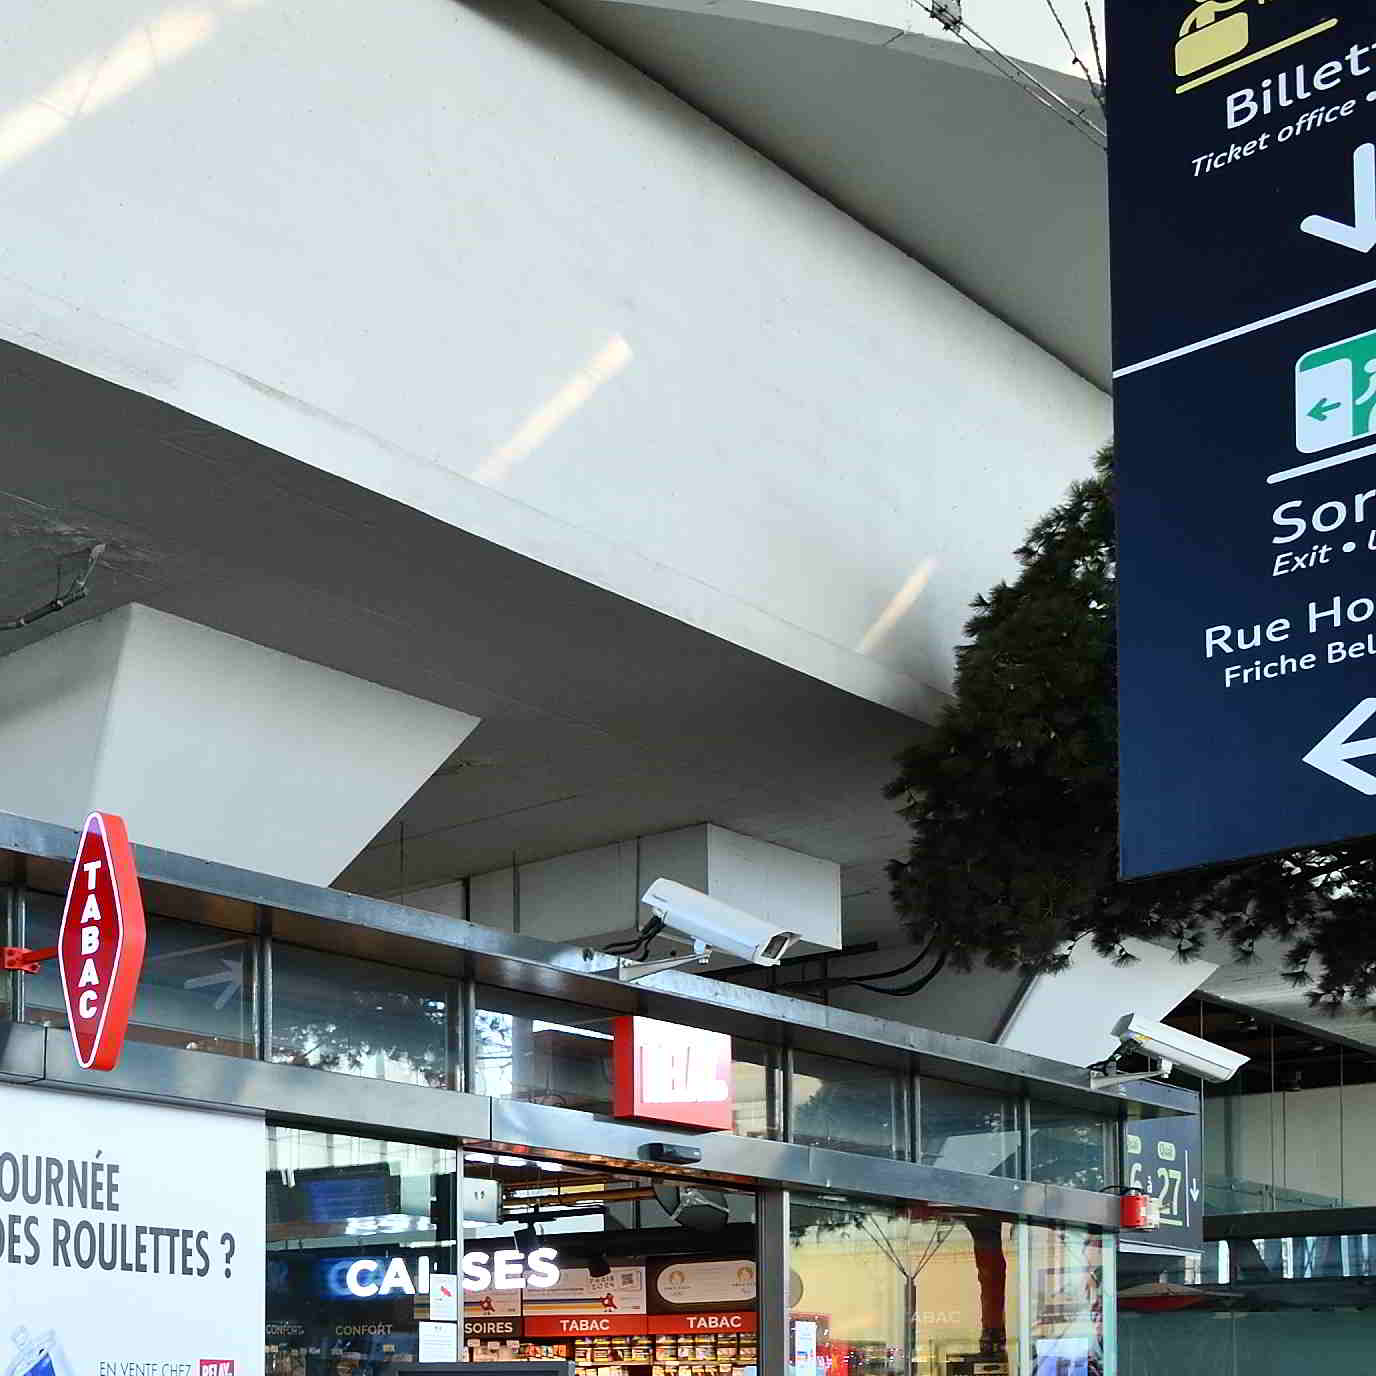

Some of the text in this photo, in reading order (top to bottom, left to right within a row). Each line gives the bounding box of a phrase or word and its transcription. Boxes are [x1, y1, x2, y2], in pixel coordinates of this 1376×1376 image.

[1226, 43, 1376, 130] Billet
[1192, 97, 1355, 177] Ticket office
[1272, 544, 1333, 577] Exit
[1205, 617, 1291, 659] Rue
[1225, 651, 1316, 688] Friche
[79, 859, 102, 1020] TABAC
[52, 1218, 209, 1277] ROULETTES
[220, 1232, 236, 1278] ?
[346, 1247, 561, 1298] CAISES
[560, 1319, 611, 1332] TABAC
[687, 1315, 742, 1329] TABAC
[99, 1361, 117, 1376] EN
